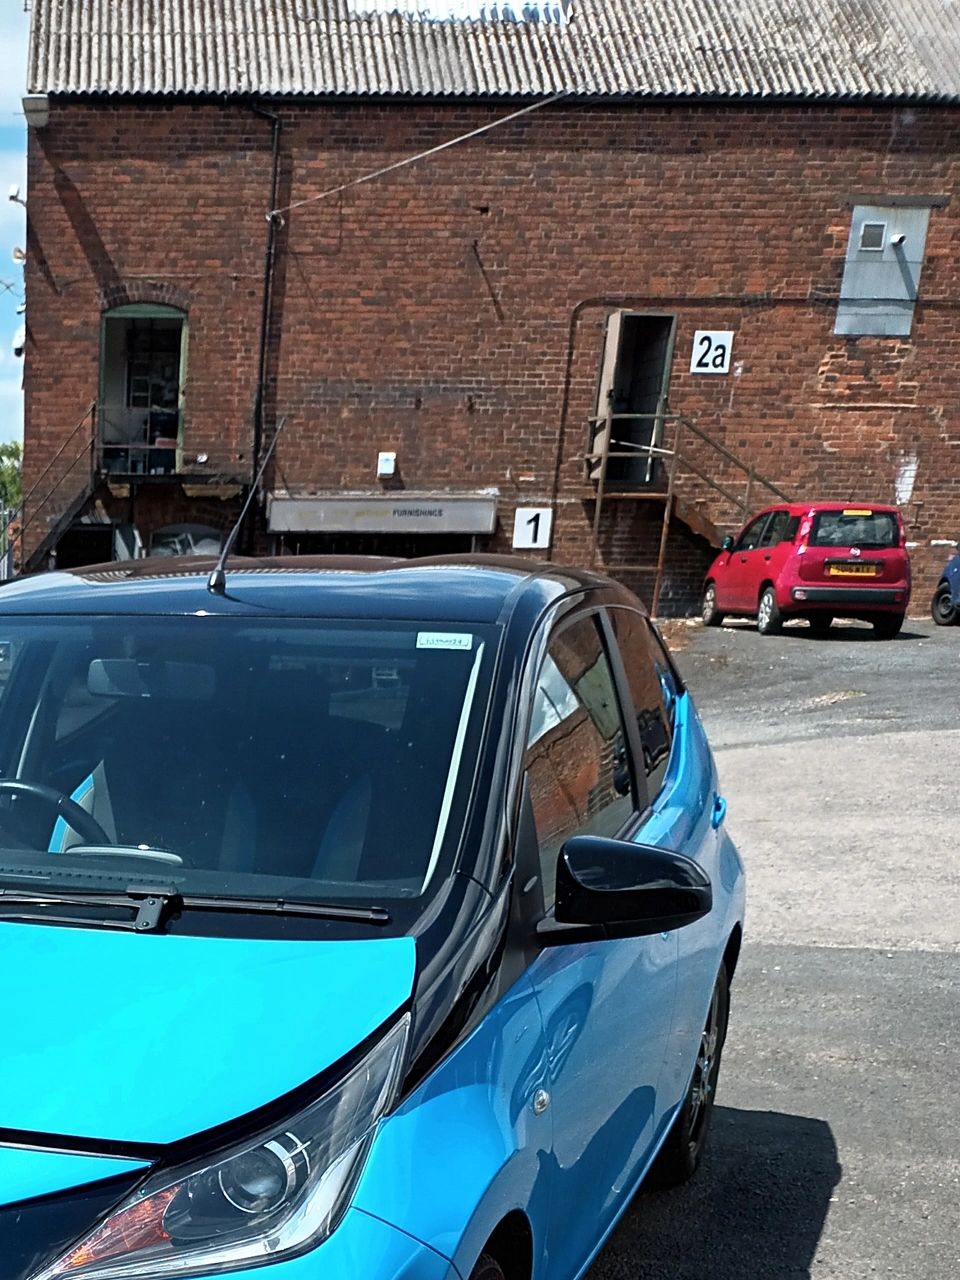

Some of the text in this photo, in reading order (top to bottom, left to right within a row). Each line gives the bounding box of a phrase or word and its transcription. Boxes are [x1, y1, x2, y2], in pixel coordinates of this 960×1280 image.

[695, 335, 726, 369] 2a
[392, 508, 443, 518] FURNISHINGS
[526, 512, 541, 544] 1
